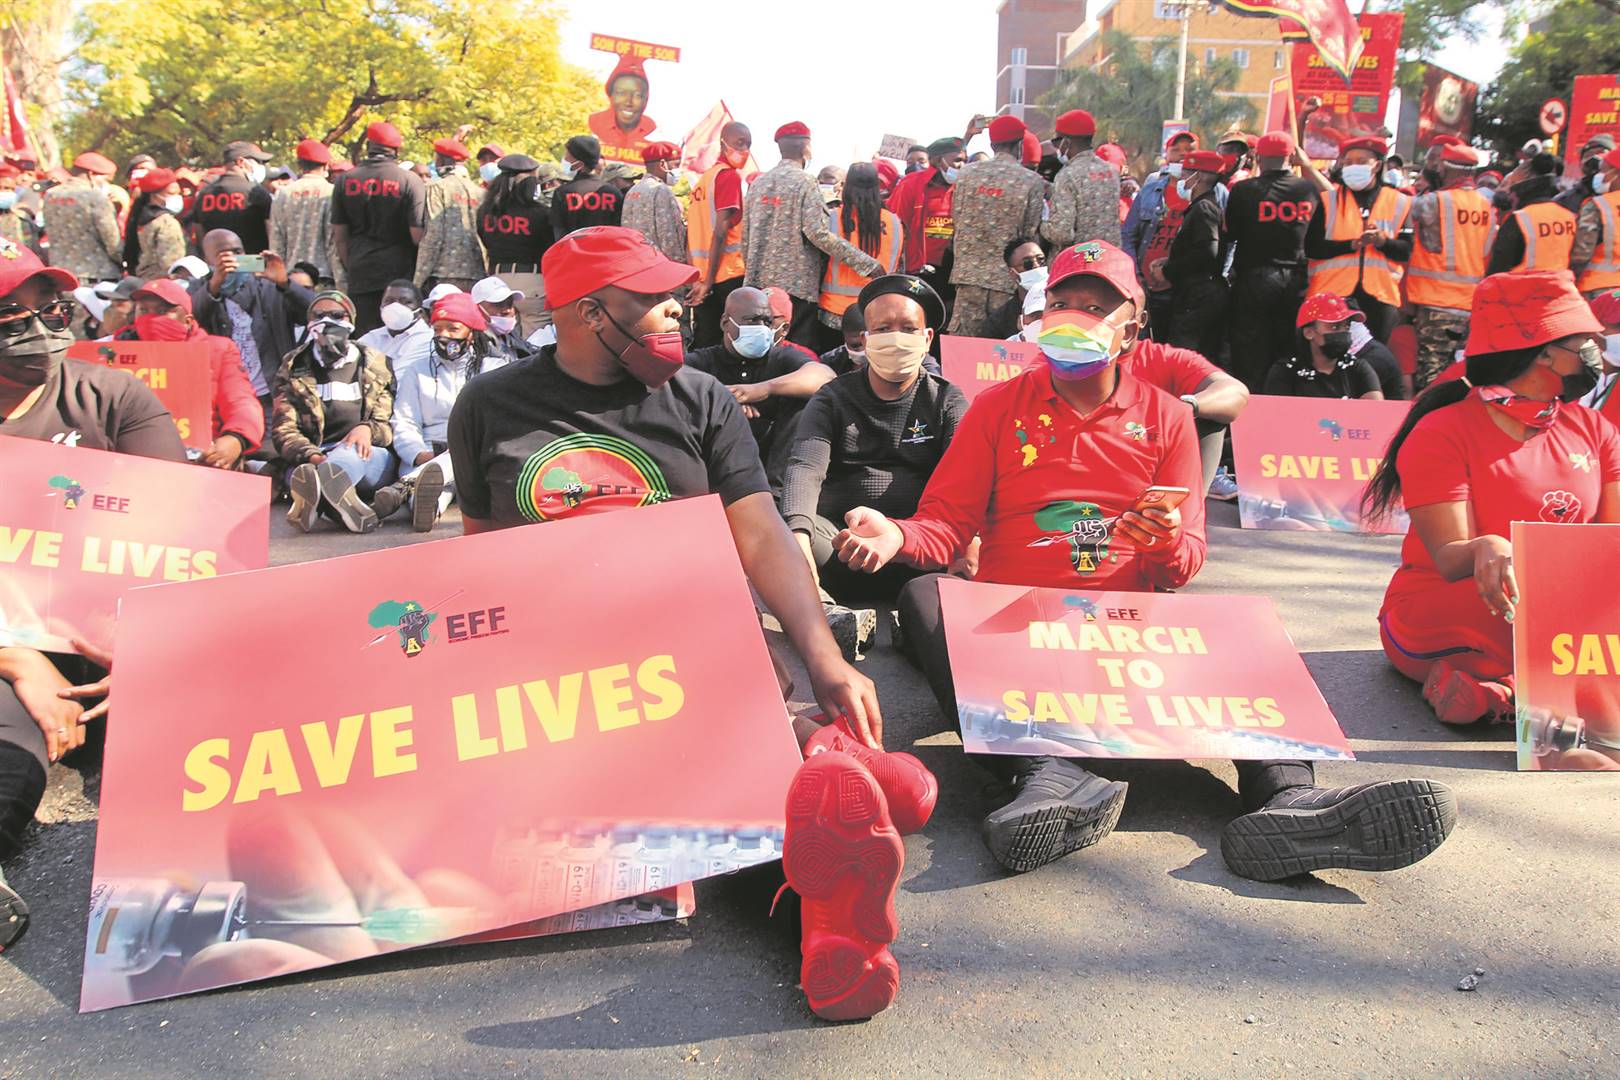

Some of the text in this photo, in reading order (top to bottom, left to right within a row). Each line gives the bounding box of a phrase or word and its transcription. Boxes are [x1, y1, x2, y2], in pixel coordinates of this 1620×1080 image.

[345, 178, 400, 197] DOR
[202, 193, 245, 212] DOR
[566, 192, 617, 212] DOR
[1258, 201, 1313, 222] DOR
[1457, 209, 1490, 226] DOR
[1538, 221, 1575, 238] DOR
[976, 361, 1022, 381] MAR
[1347, 428, 1371, 440] EFF
[1260, 454, 1340, 479] SAVE
[92, 494, 130, 511] EFF
[81, 536, 217, 581] LIVES
[446, 606, 505, 639] EFF
[1105, 607, 1140, 620] EFF
[1028, 621, 1208, 655] MARCH
[1097, 658, 1164, 689] TO
[1002, 690, 1286, 728] SAVE LIVES
[182, 653, 685, 812] SAVE LIVES
